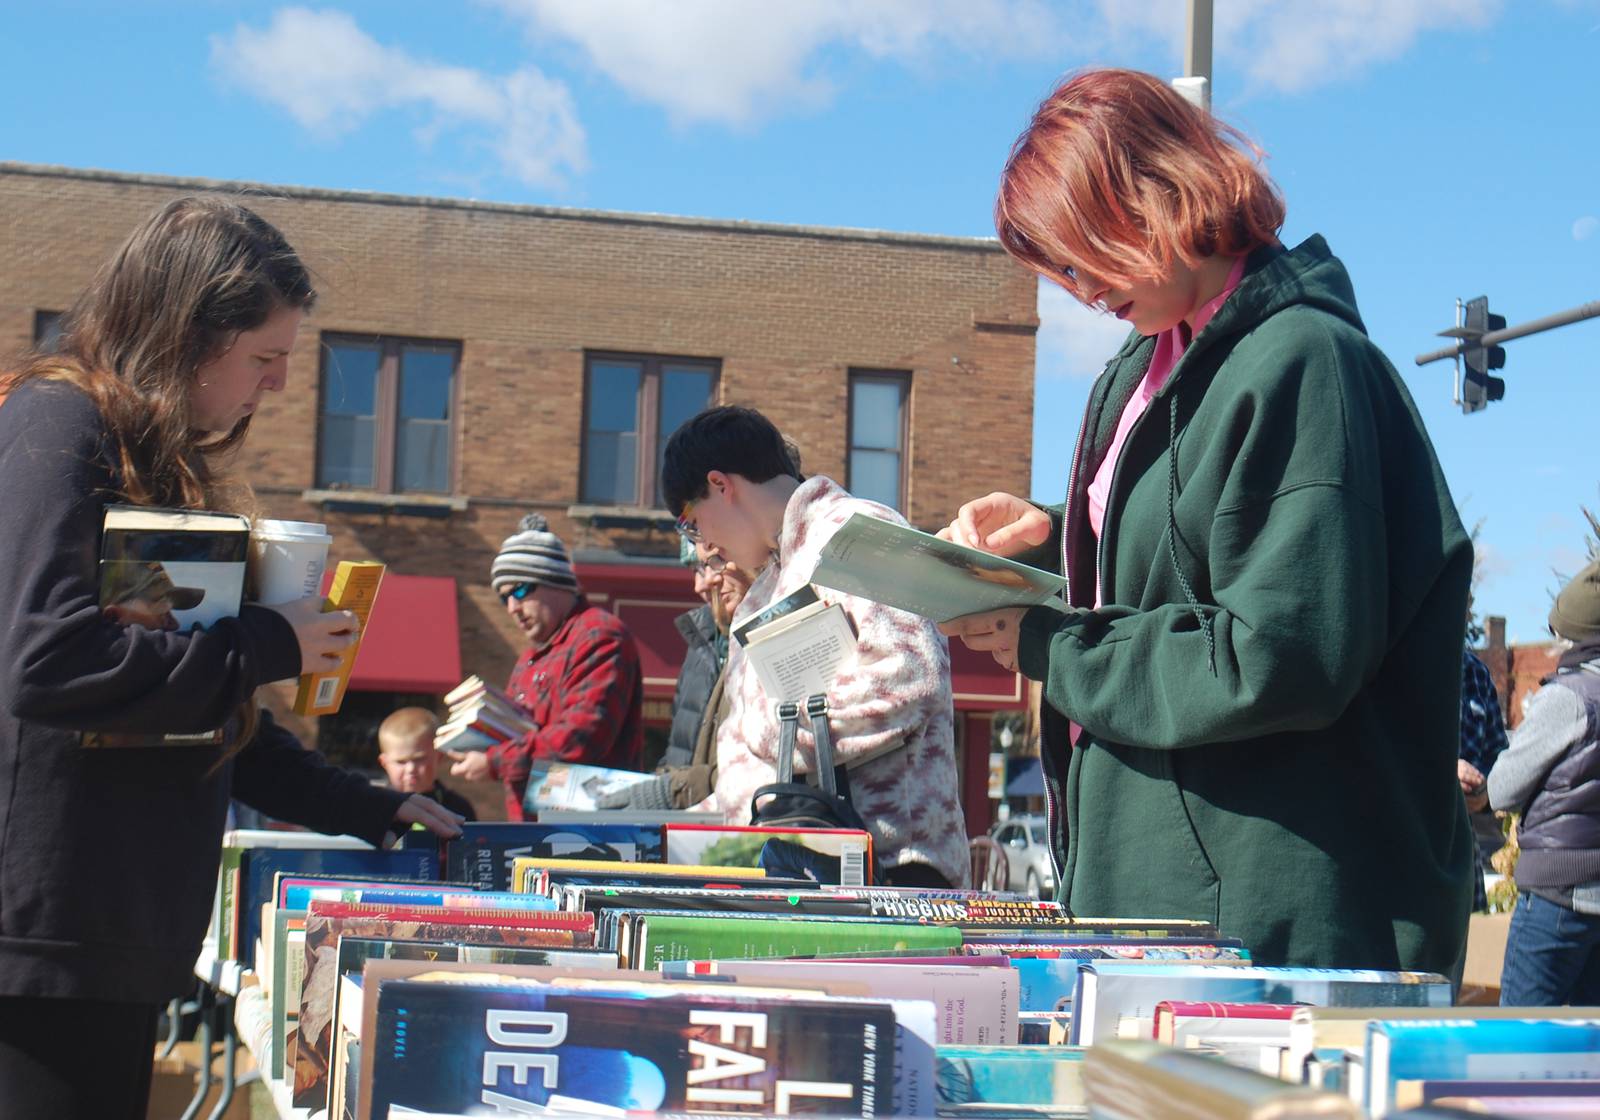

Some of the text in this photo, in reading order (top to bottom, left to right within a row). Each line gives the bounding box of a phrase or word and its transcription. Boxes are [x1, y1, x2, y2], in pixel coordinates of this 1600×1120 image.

[883, 902, 968, 919] HIGGINS
[984, 905, 1021, 918] JUDAS
[1024, 907, 1053, 919] GATE
[393, 1020, 408, 1059] NOVEL
[687, 1010, 767, 1117] FAI
[861, 1023, 877, 1118] NEW YORK TIMES
[774, 1079, 855, 1117] L
[908, 1069, 919, 1117] NATION
